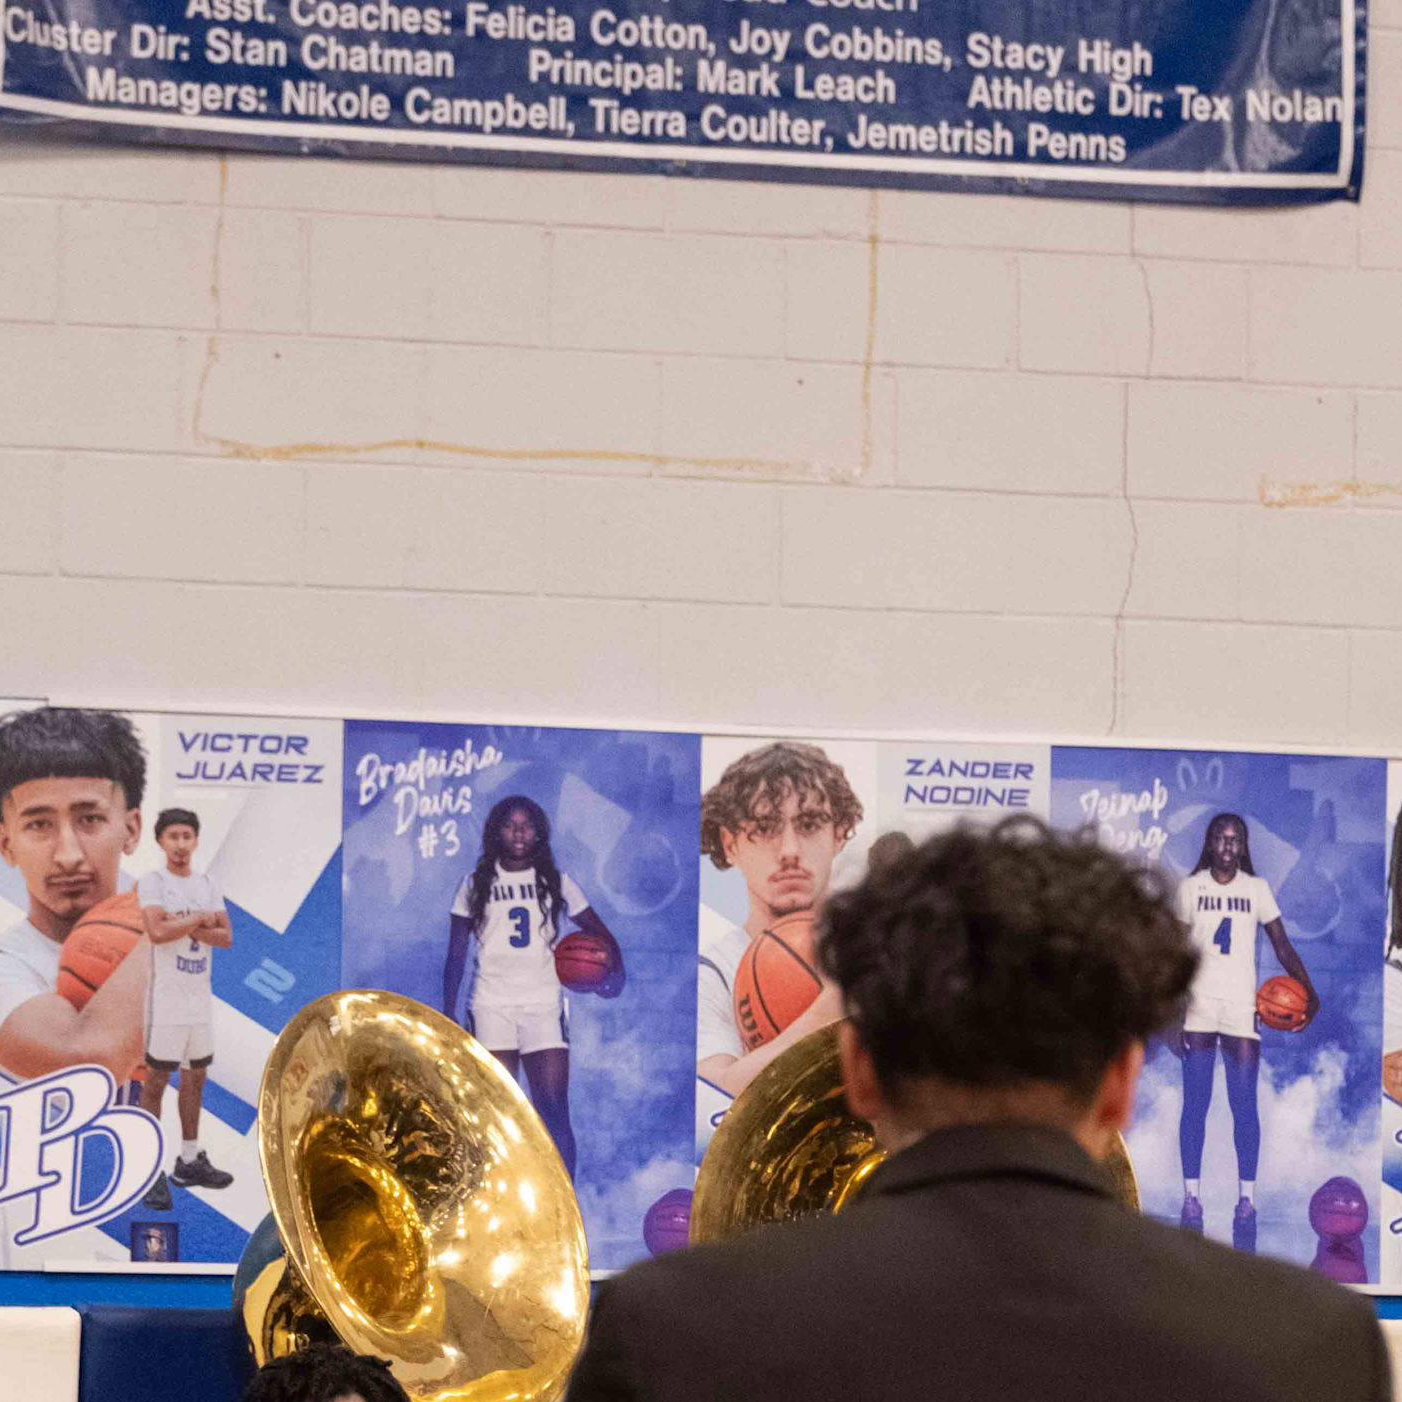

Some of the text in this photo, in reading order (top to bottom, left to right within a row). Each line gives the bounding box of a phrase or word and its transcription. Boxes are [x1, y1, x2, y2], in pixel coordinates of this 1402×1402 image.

[289, 0, 452, 36] Coaches:
[465, 2, 576, 43] Felicia
[590, 9, 716, 57] Cotton,
[729, 19, 792, 62] Joy
[804, 22, 952, 72] Cobbins,
[966, 32, 1064, 79] Stacy
[1078, 39, 1153, 82] High
[5, 6, 1343, 123] Cluster Dir: Stan Chatman Principal: Mark Leach Athletic Dir: Tex Nolan
[86, 67, 1127, 163] Managers: Nikole Campbell, Tierra Coulter, Jemetrish Penns
[177, 731, 309, 756] VICTOR
[175, 760, 325, 784] JUAREZ
[904, 758, 1035, 780] ZANDER
[393, 785, 472, 836] Davis
[903, 784, 1031, 808] NODINE
[418, 819, 461, 859] #3
[509, 907, 530, 948] 3
[1213, 917, 1232, 955] 4
